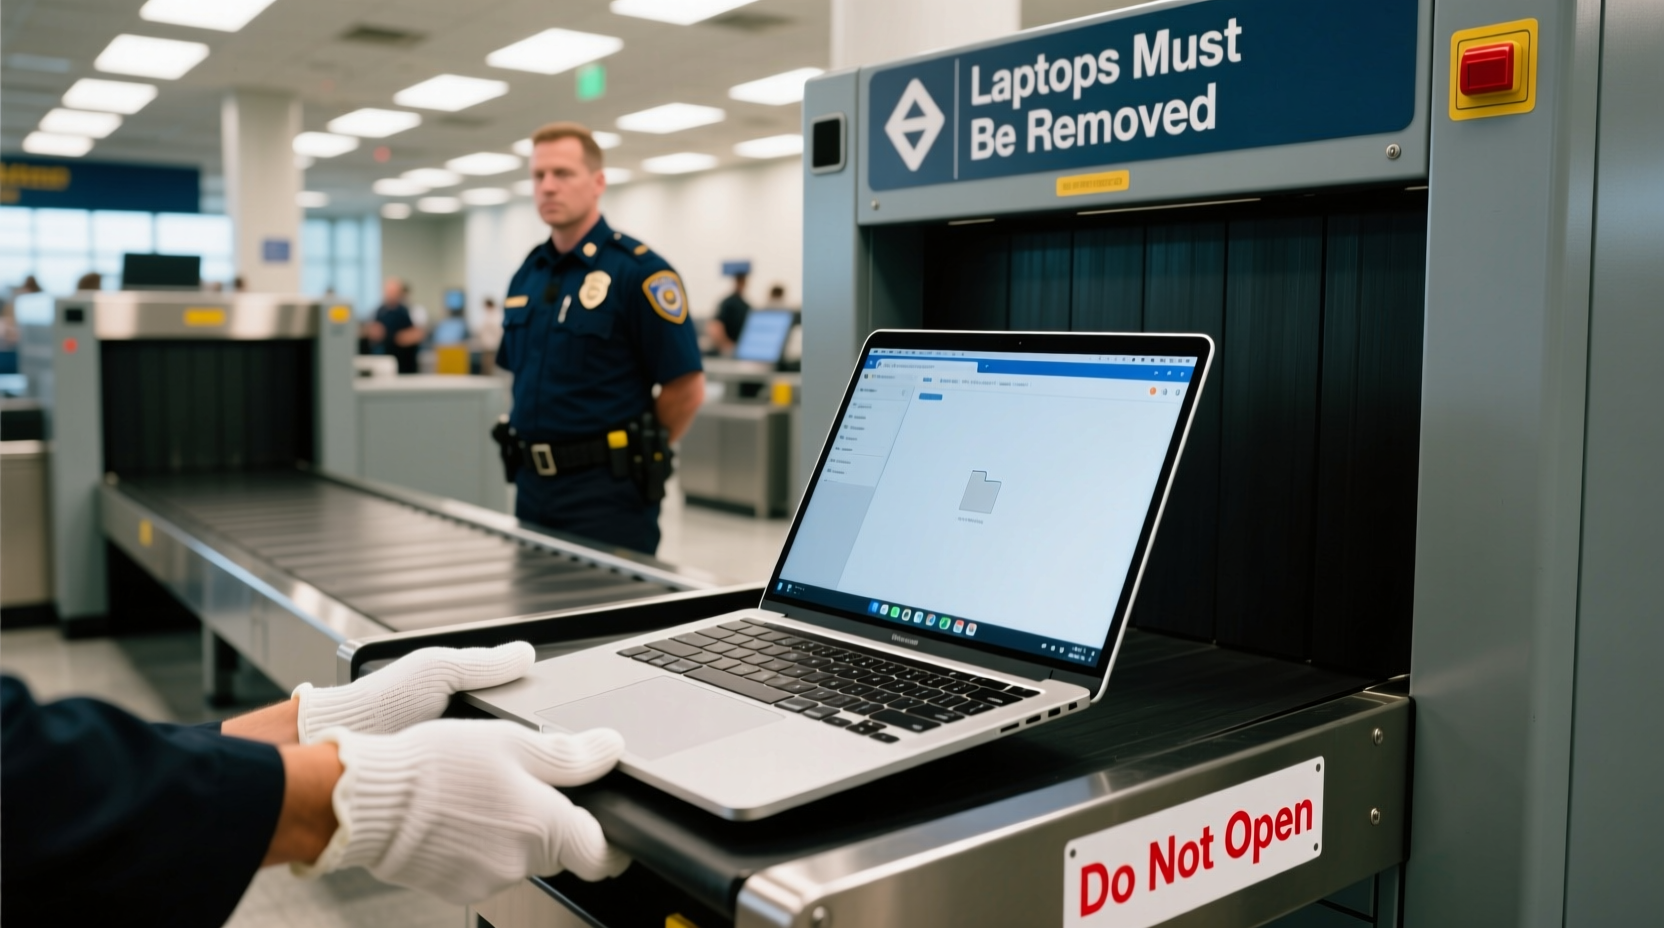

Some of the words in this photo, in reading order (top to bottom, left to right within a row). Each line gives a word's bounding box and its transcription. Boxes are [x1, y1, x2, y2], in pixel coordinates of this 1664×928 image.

[970, 48, 1121, 110] Laptops
[1132, 17, 1243, 79] Must
[969, 117, 1017, 162] Be
[1027, 82, 1217, 154] Removed
[1080, 861, 1136, 918] Do
[1148, 825, 1214, 891] Not
[1224, 798, 1313, 864] Open
